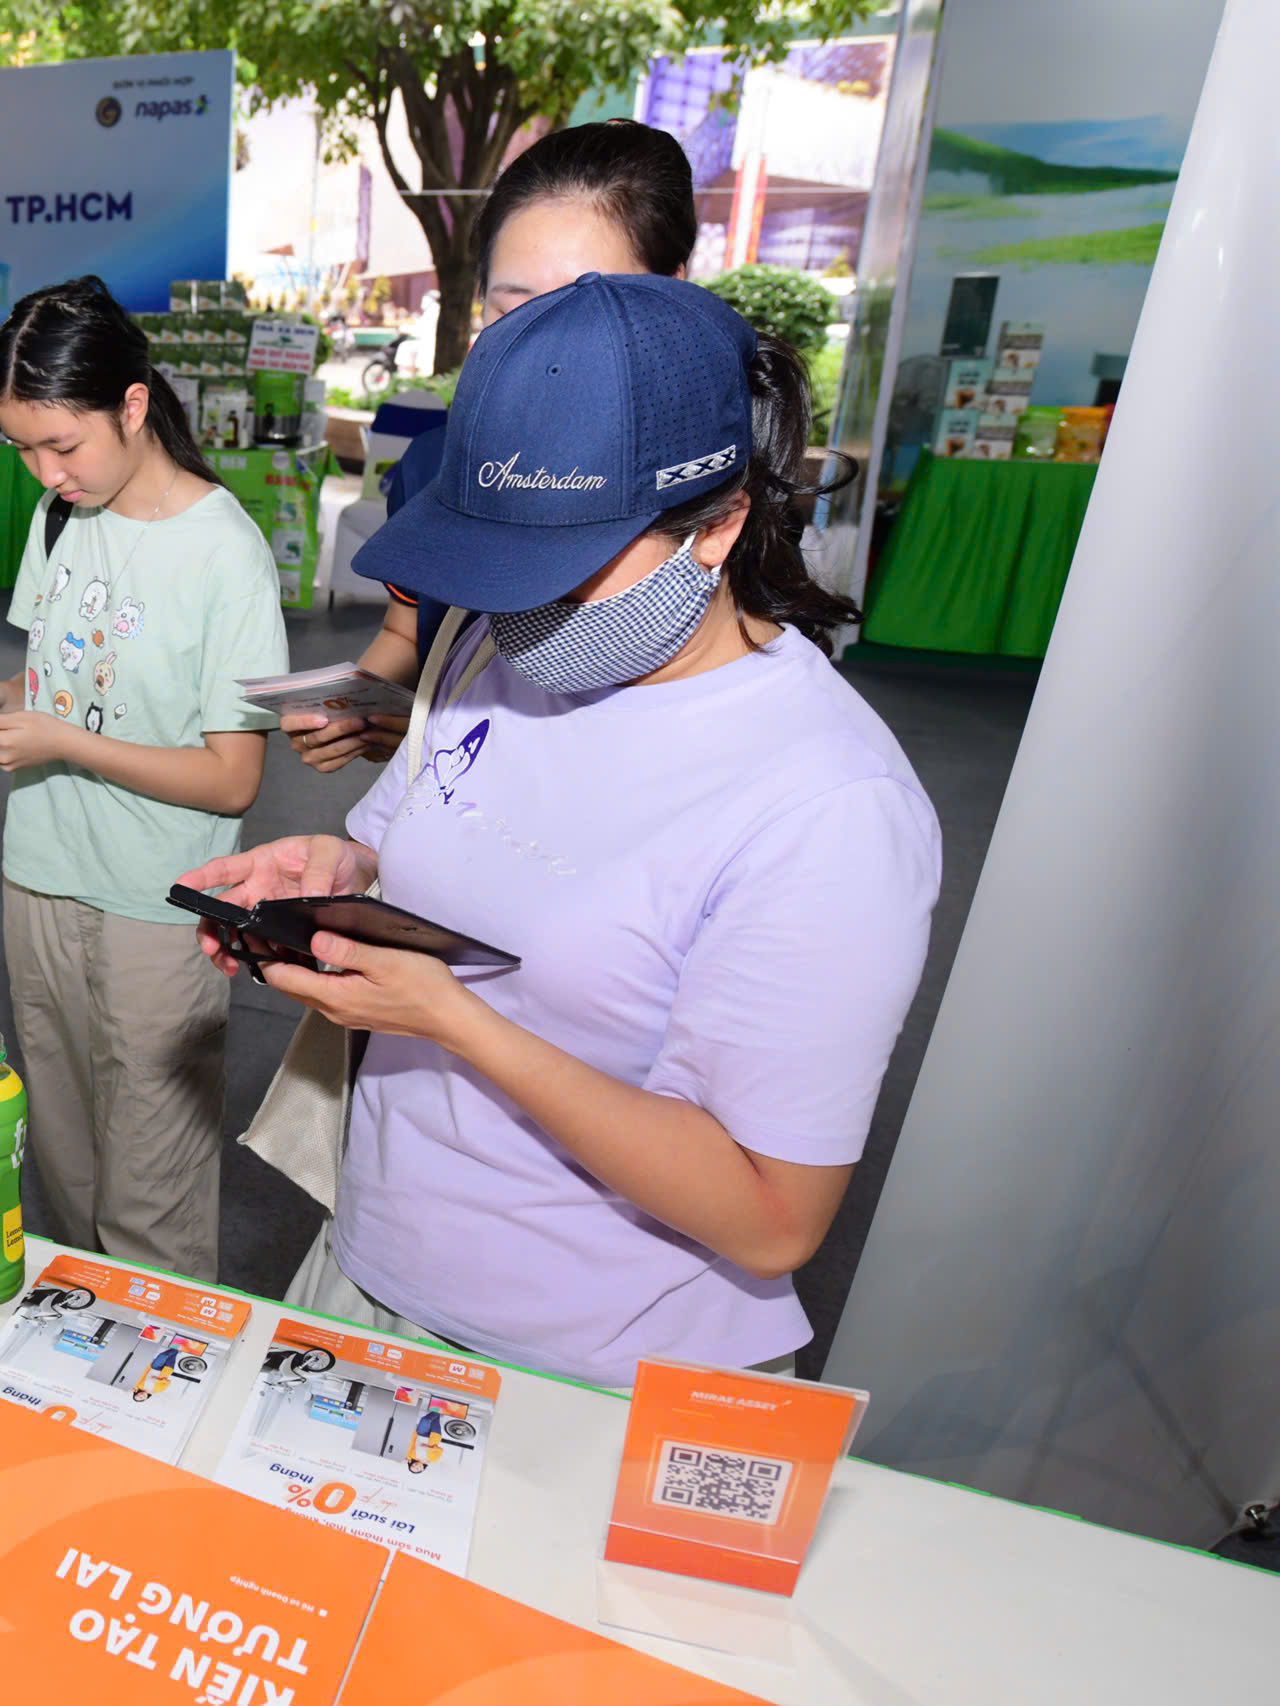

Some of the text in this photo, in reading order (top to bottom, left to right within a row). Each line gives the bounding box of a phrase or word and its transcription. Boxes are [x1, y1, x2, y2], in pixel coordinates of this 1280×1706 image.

[135, 99, 193, 123] napas
[6, 190, 133, 224] TP.HCM
[478, 451, 608, 491] Amsterdam
[2, 1385, 43, 1407] tháng
[690, 1391, 734, 1405] MIRAE
[269, 1463, 314, 1485] tháng
[287, 1480, 357, 1515] 0%
[351, 1508, 416, 1535] Lãi suất
[414, 1546, 441, 1561] Mua
[55, 1547, 310, 1675] TƯƠNG LAI
[68, 1608, 296, 1706] KIẾN TẠO
